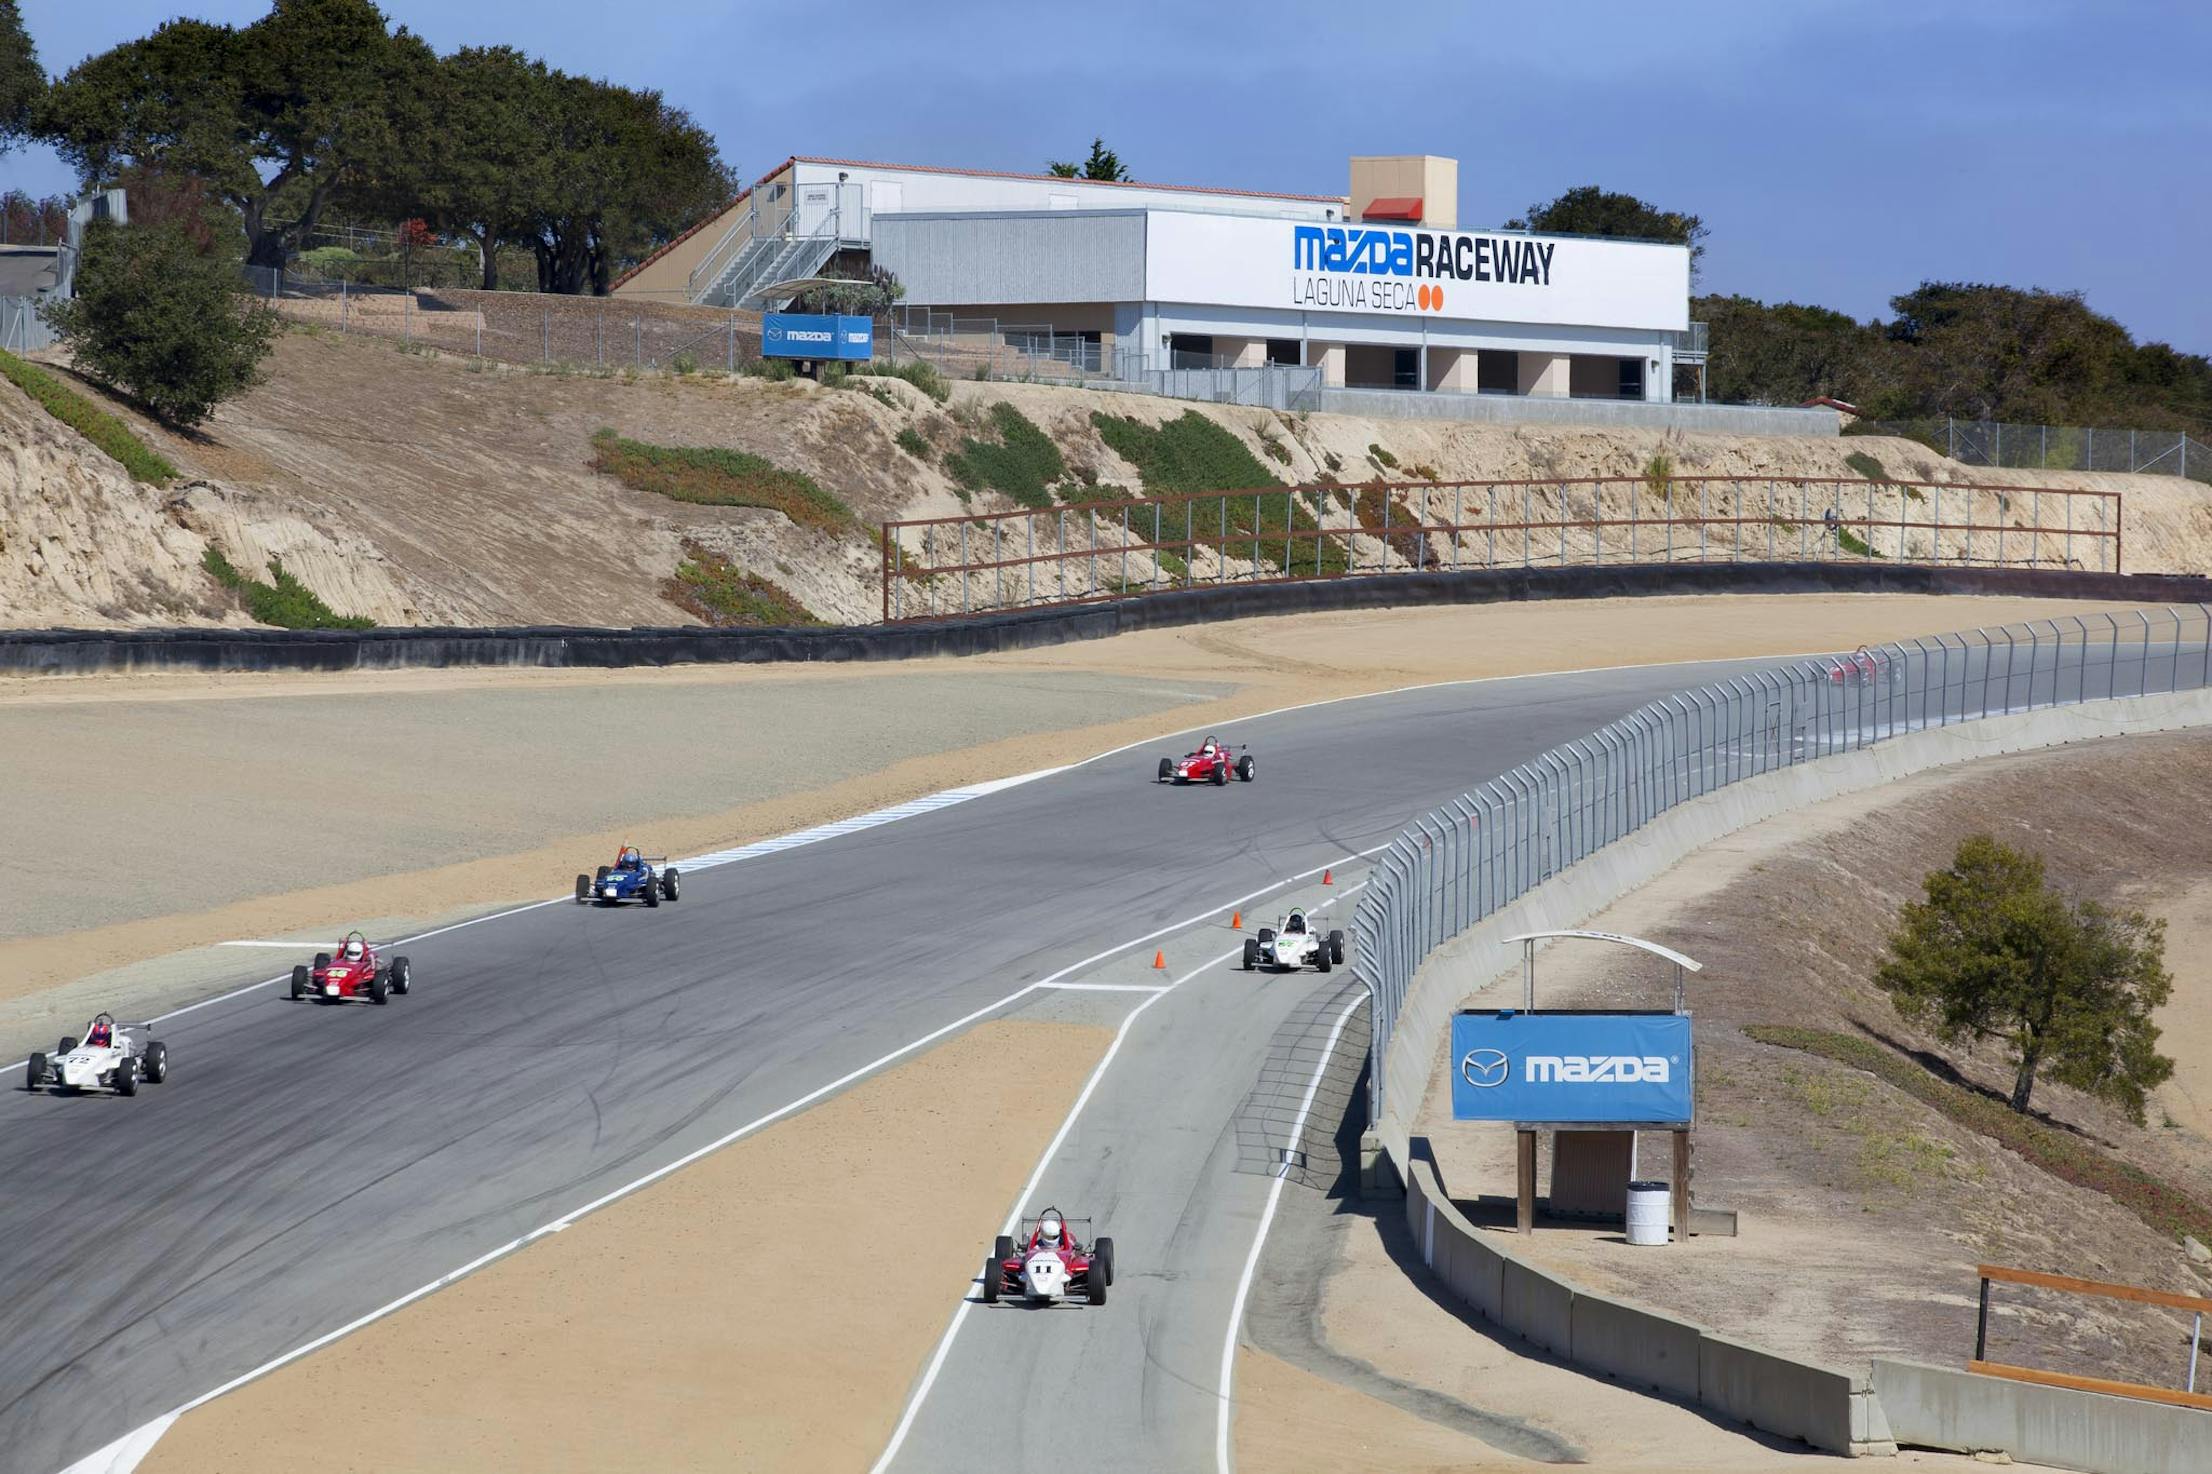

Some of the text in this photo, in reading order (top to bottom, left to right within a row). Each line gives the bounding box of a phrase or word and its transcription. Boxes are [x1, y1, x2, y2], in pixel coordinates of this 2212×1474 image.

[1416, 233, 1555, 285] RACEWAY
[1293, 276, 1416, 312] LAGUNA SECA
[68, 1056, 91, 1065] 72
[1035, 1265, 1052, 1274] 11
